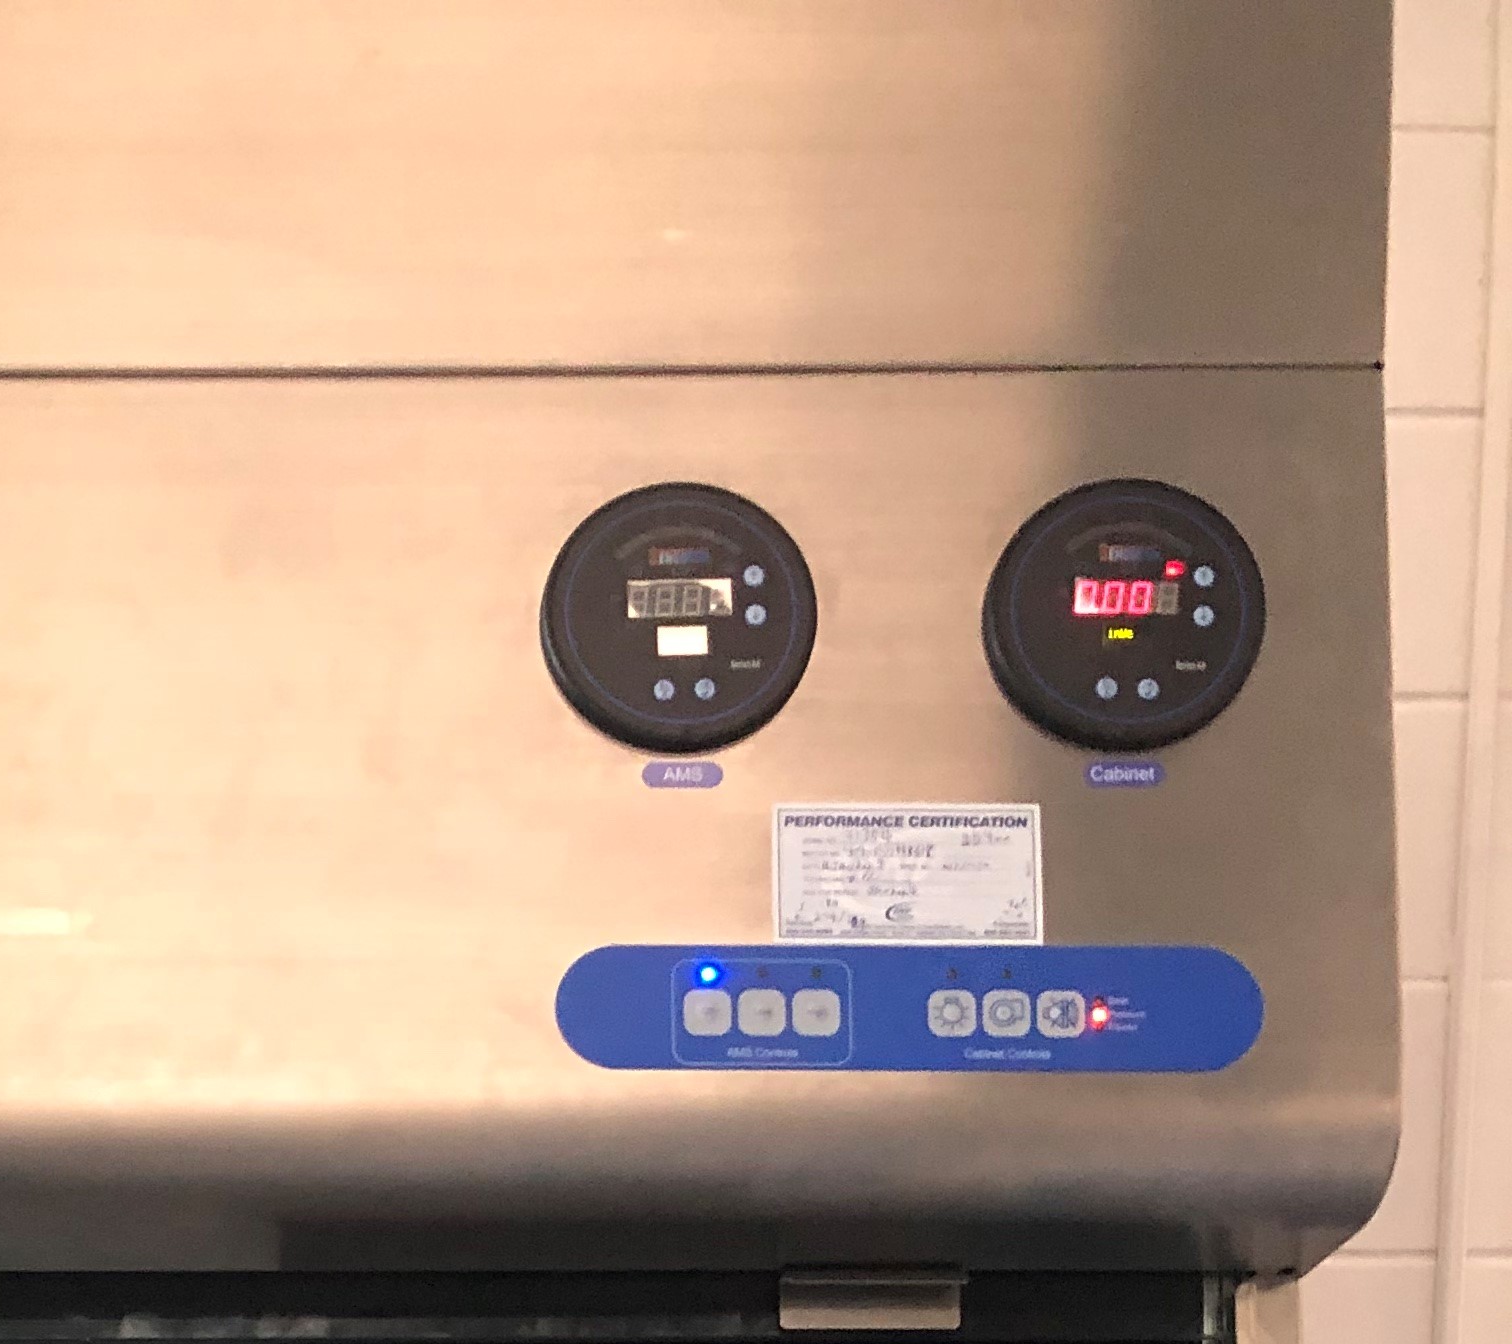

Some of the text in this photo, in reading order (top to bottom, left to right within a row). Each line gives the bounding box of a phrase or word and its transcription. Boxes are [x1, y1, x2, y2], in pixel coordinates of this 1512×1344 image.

[663, 766, 703, 782] AMS
[1090, 764, 1155, 781] Cabinet
[784, 815, 1028, 828] PERFORMANCE CERTIFICATION
